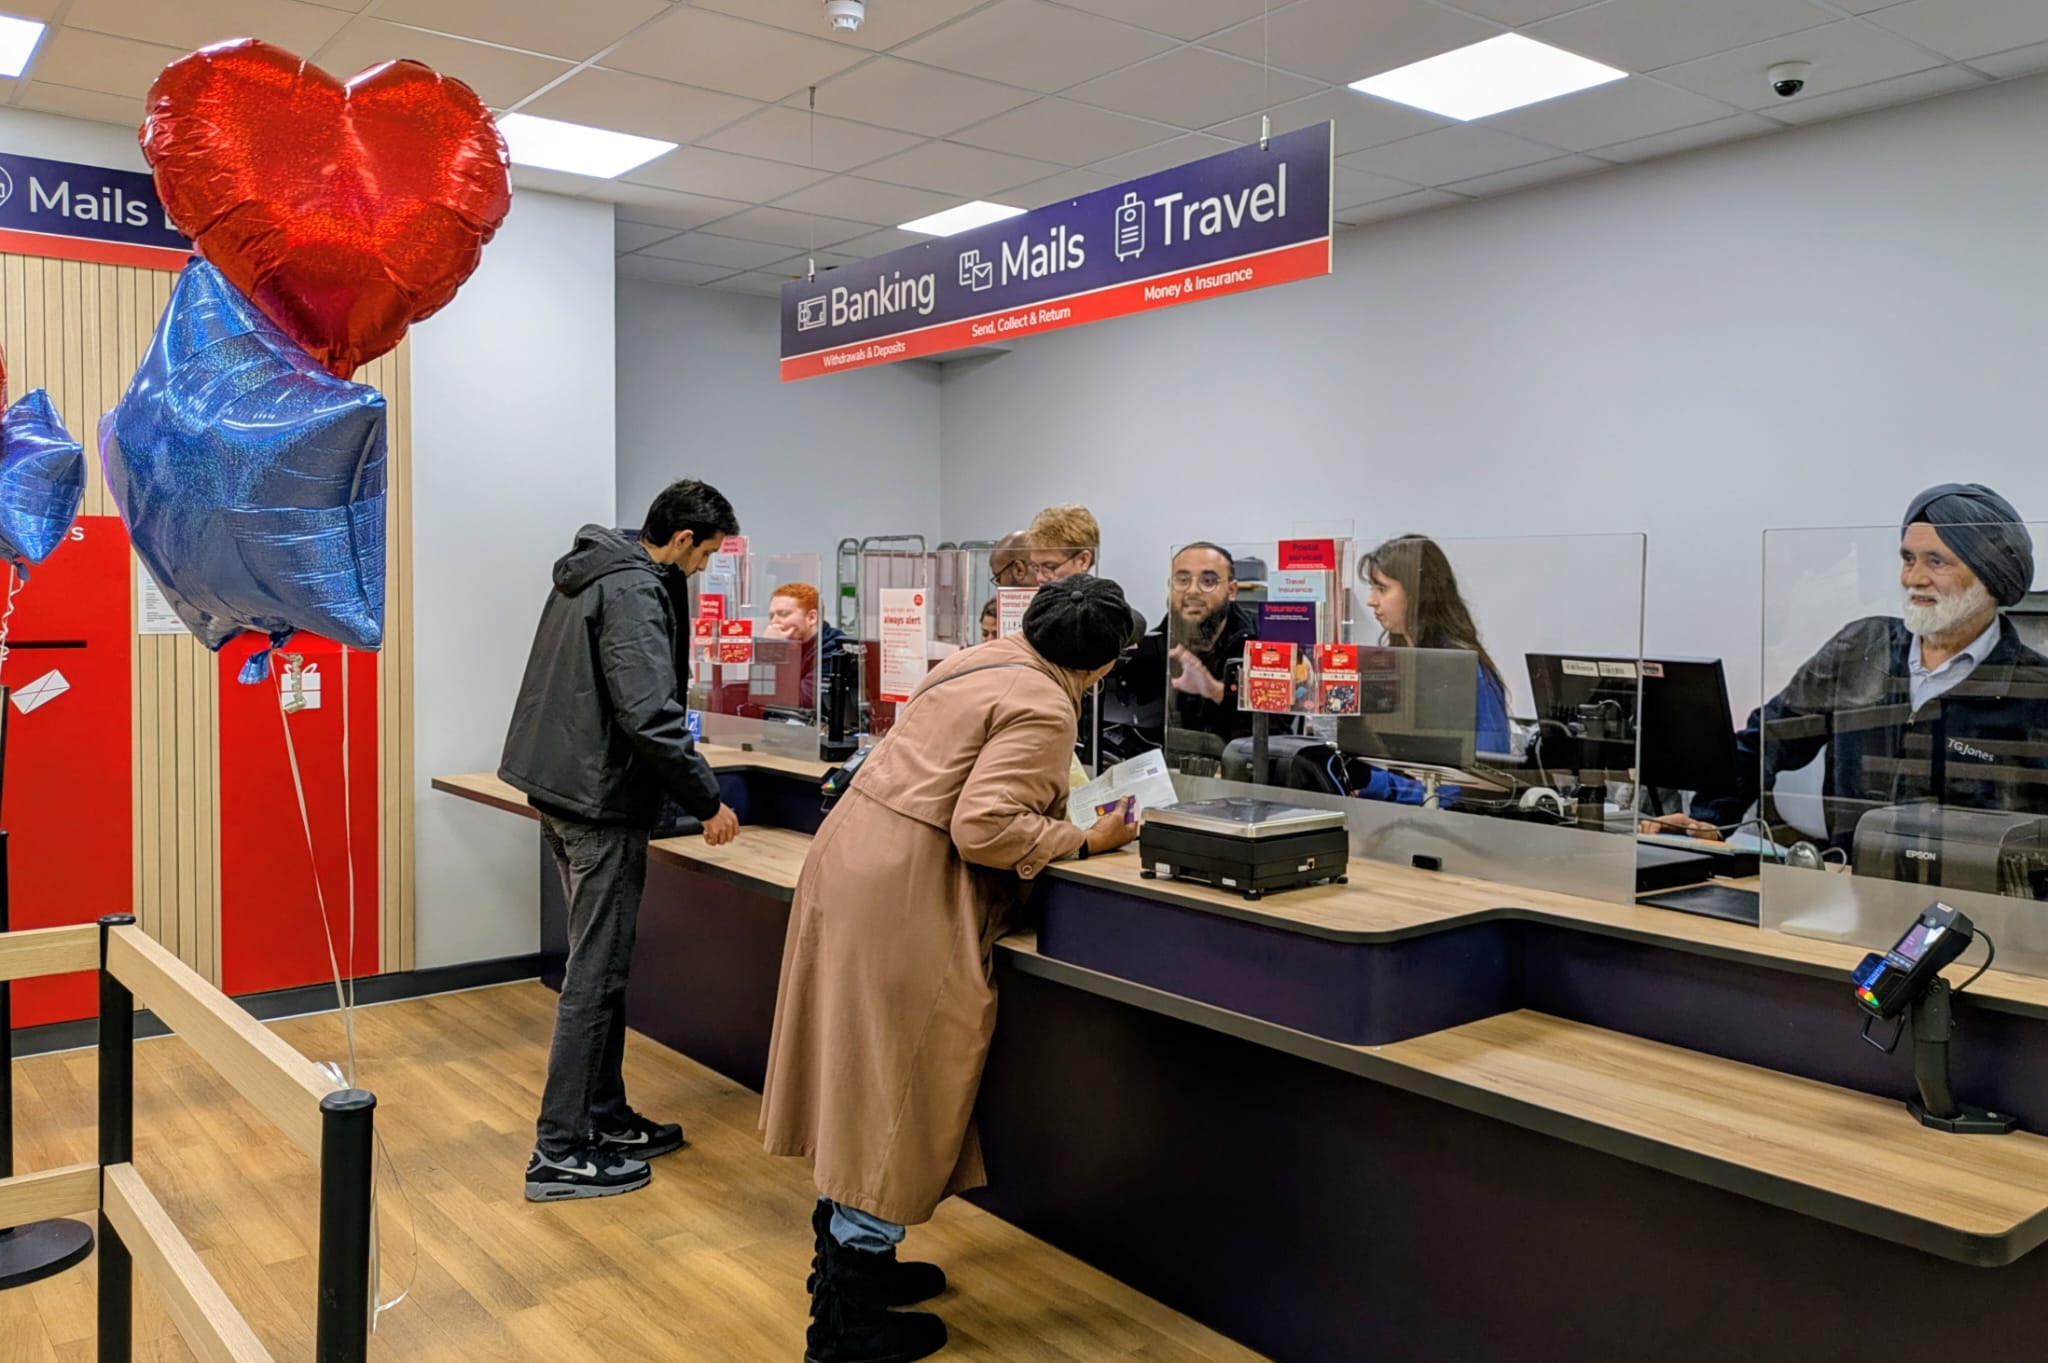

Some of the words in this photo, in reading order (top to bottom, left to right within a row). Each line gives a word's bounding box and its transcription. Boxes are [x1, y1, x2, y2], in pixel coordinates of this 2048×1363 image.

[29, 176, 149, 228] Mails
[1154, 162, 1287, 246] Travel
[1001, 225, 1086, 286] Mails
[831, 271, 936, 327] Banking
[1144, 283, 1182, 302] Money
[1183, 278, 1194, 293] &
[1195, 268, 1253, 290] Insurance
[971, 320, 997, 337] Send,
[997, 314, 1029, 332] Collect
[1029, 311, 1037, 325] &
[1038, 307, 1071, 324] Return
[823, 349, 866, 367] Withdrawals
[866, 347, 873, 359] &
[873, 341, 906, 358] Deposits
[1285, 577, 1306, 585] Travel
[883, 616, 904, 626] always
[905, 615, 921, 625] alert
[1264, 604, 1308, 614] Insurance
[1946, 737, 1995, 762] TGJones
[1905, 849, 1937, 861] EPSON
